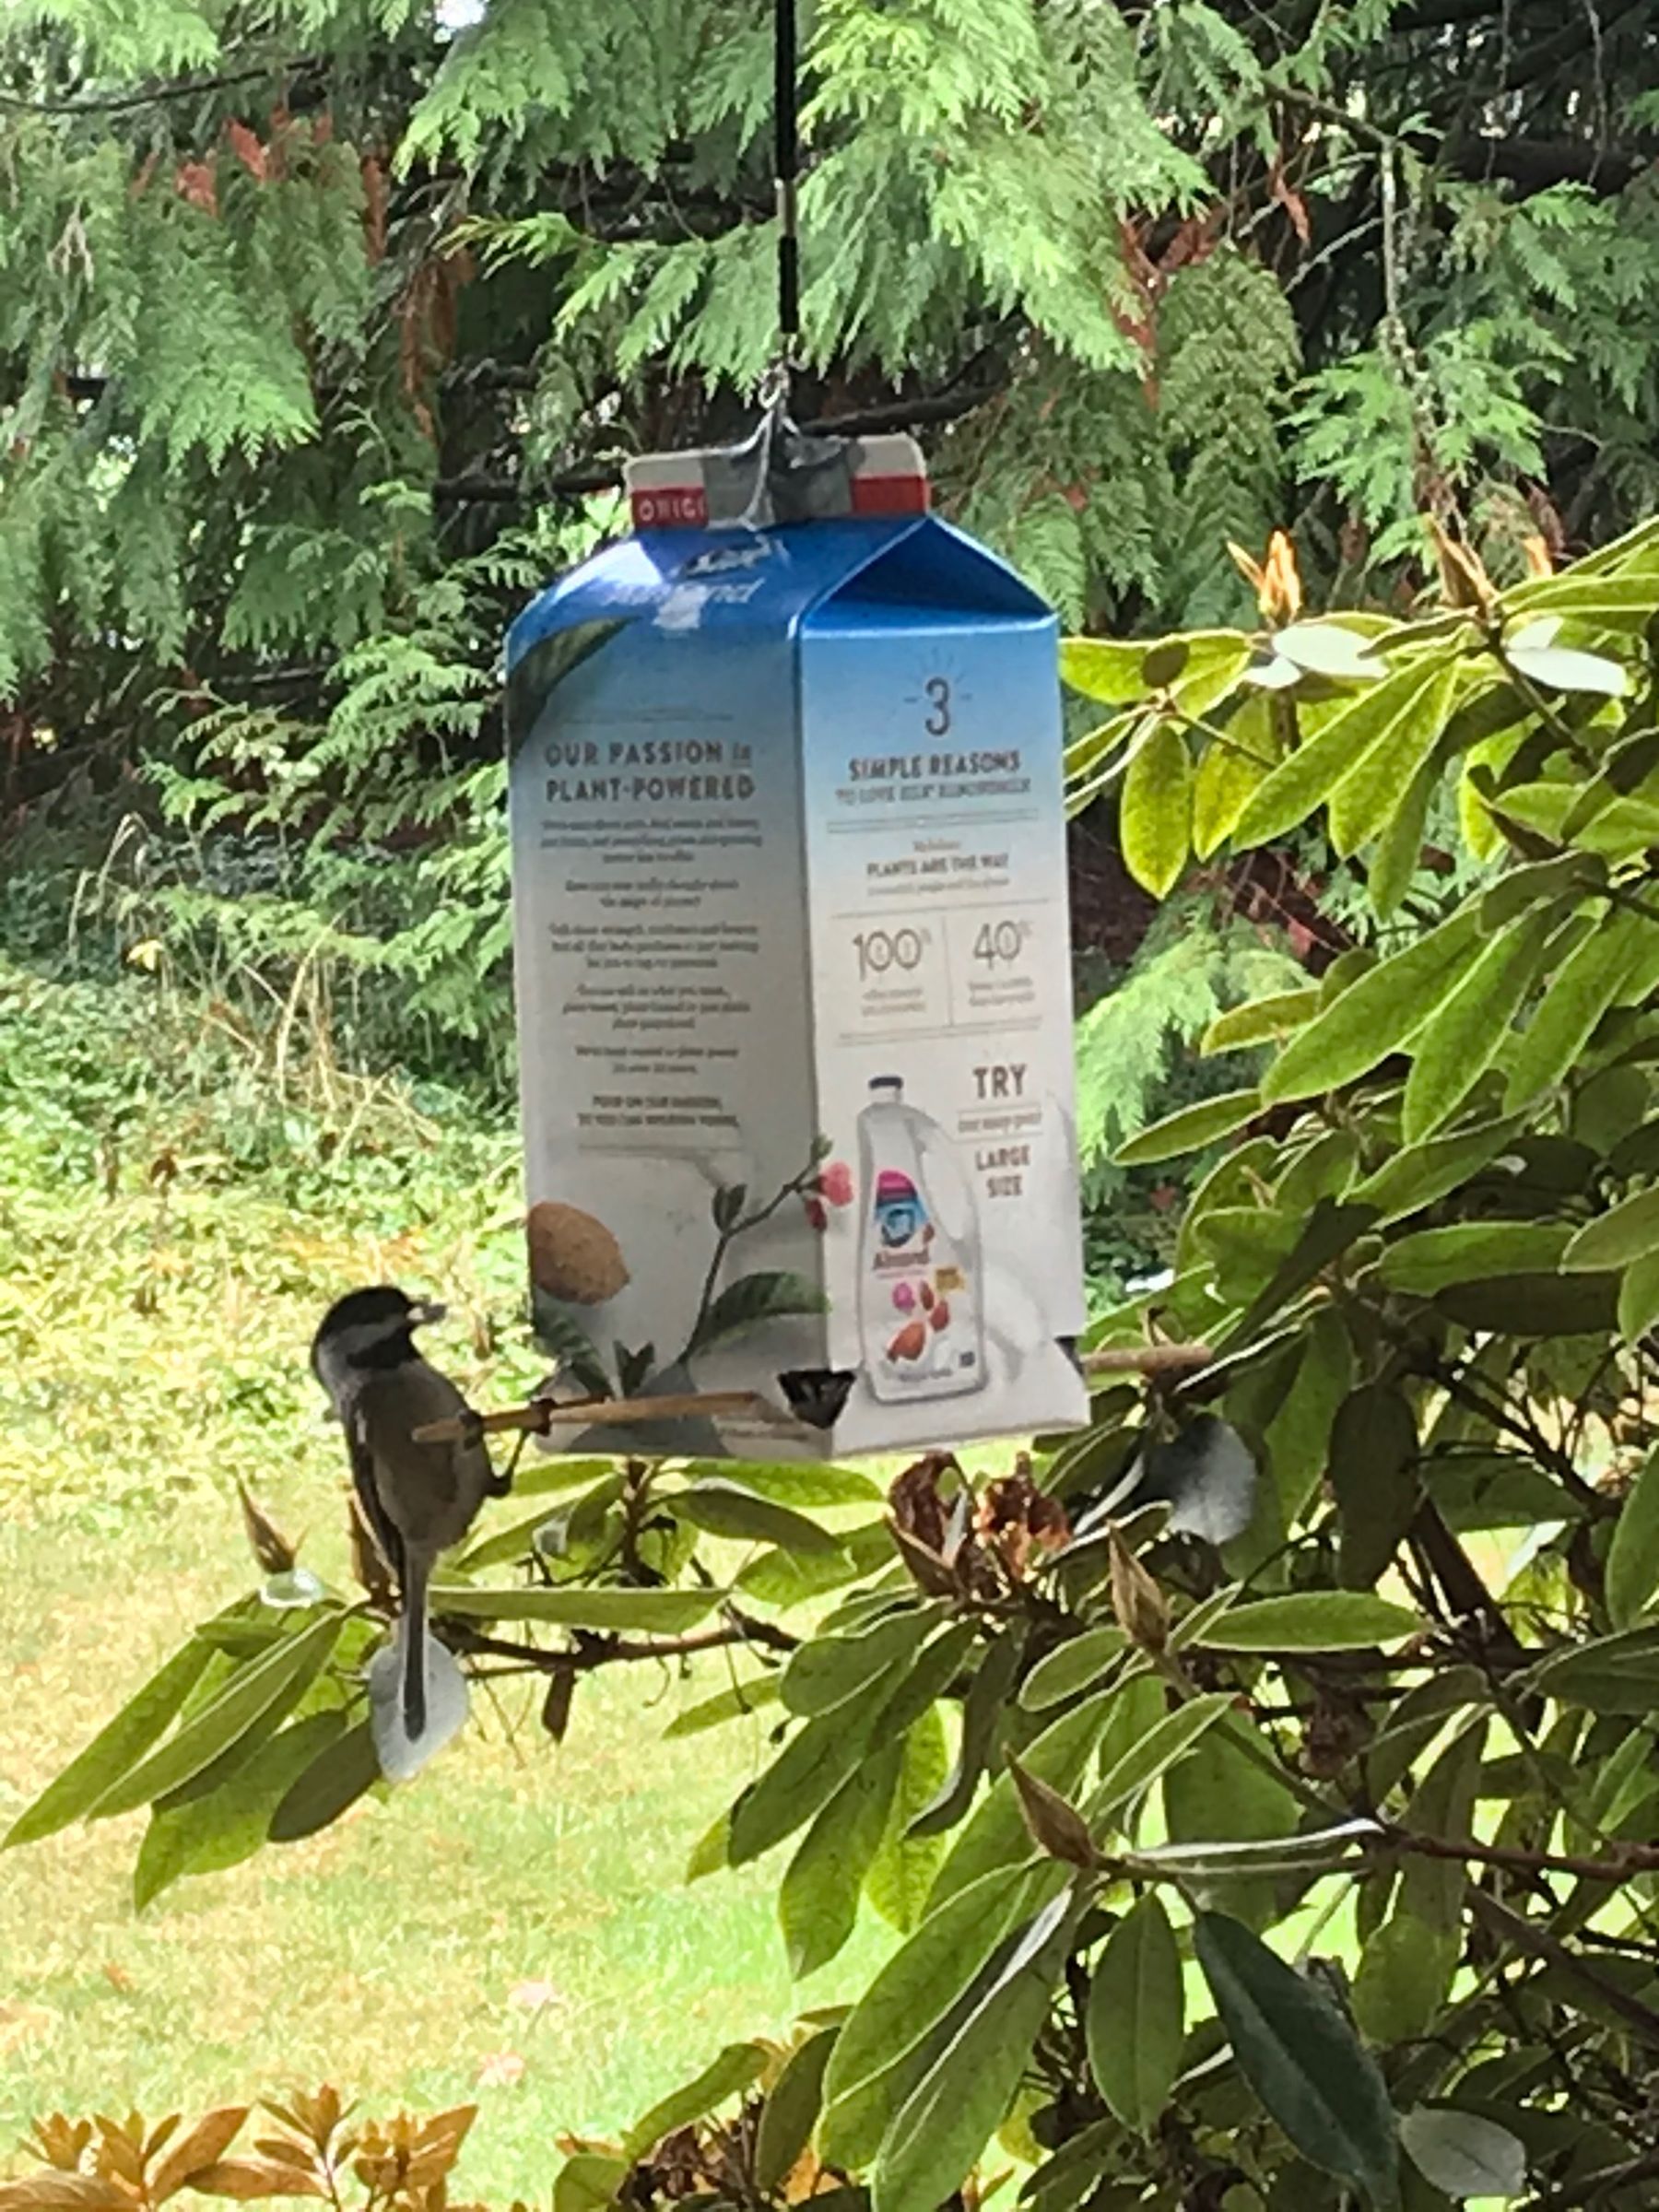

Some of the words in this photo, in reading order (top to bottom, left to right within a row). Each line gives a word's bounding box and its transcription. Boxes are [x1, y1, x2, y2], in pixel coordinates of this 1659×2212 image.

[924, 676, 952, 736] 3
[545, 742, 599, 767] OUR
[608, 740, 723, 765] PASSION
[848, 753, 923, 782] SIMPLE
[929, 750, 1021, 777] REASONS
[547, 773, 756, 802] PLANT-POWERED
[973, 1064, 1028, 1099] TRY
[975, 1145, 1031, 1171] LARGE
